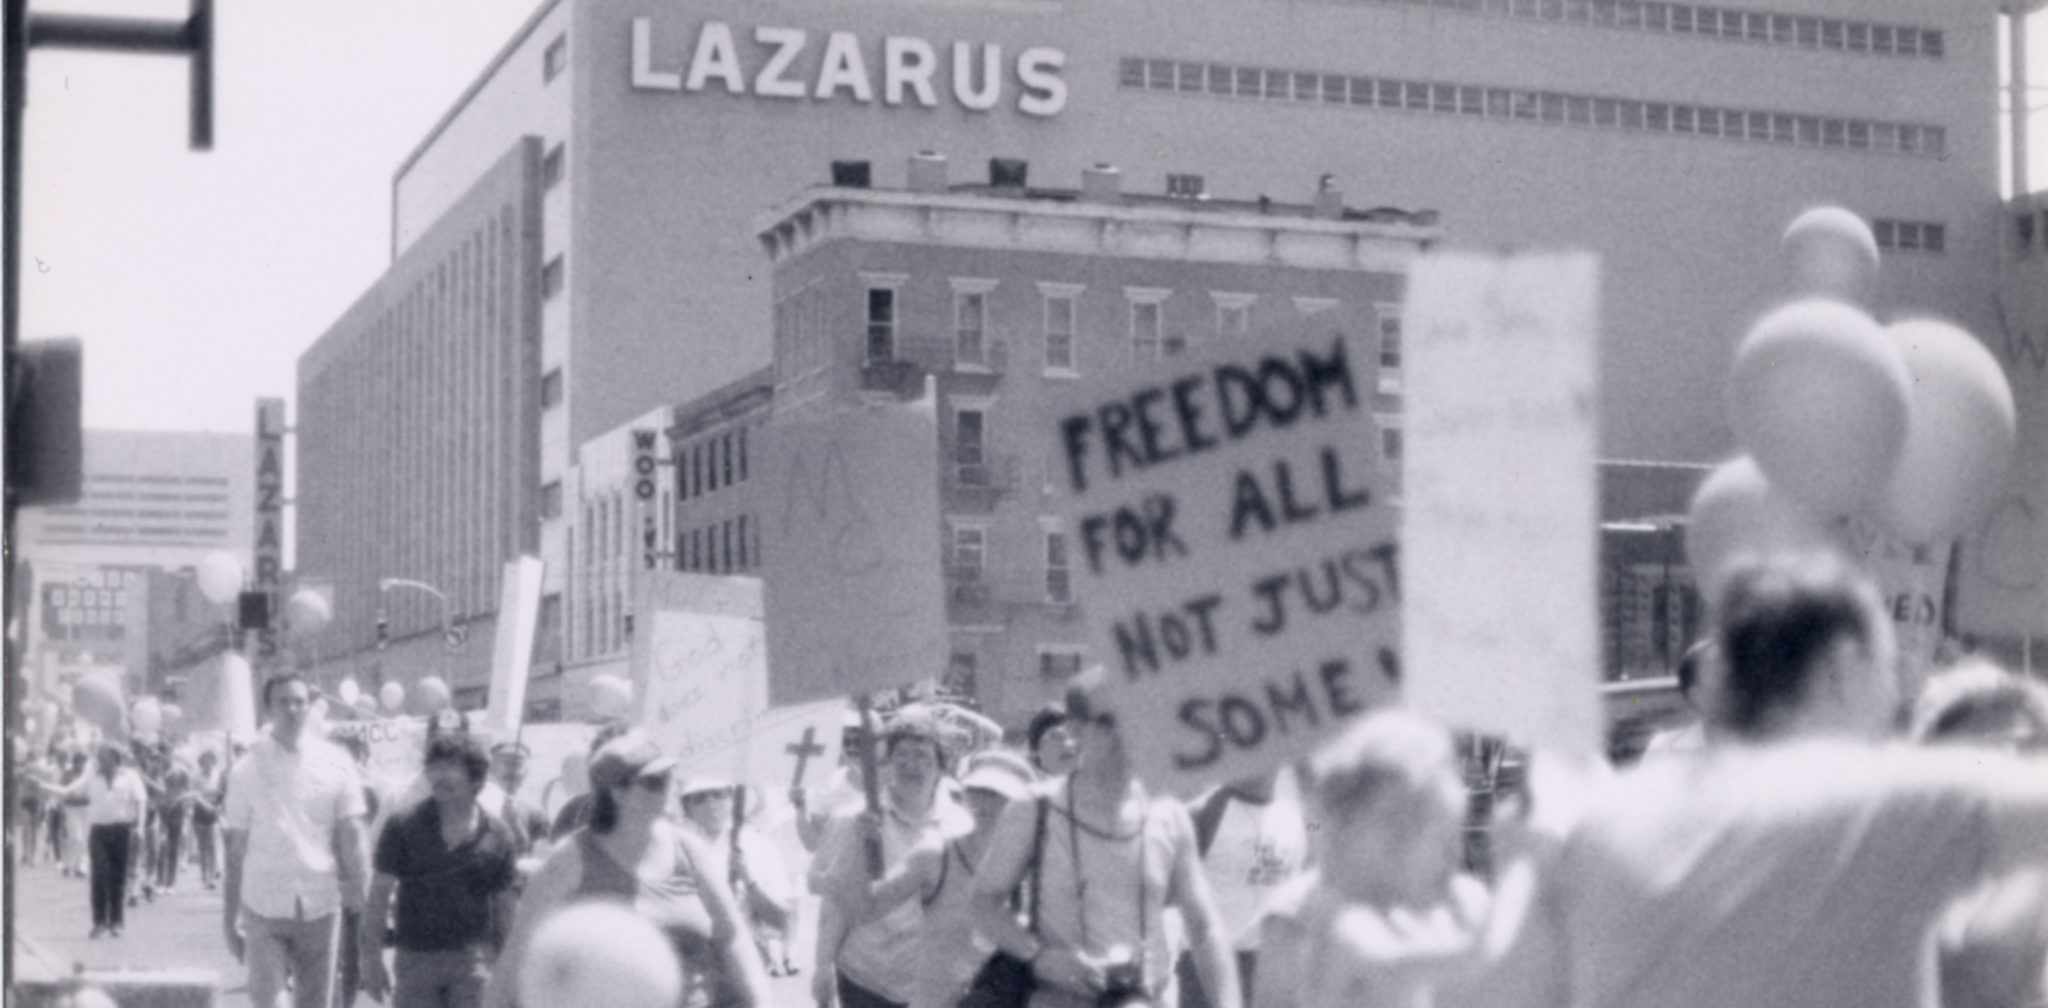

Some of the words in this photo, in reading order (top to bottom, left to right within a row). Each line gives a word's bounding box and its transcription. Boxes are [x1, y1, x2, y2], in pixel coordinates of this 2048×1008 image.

[632, 17, 1069, 117] LAZARUS
[1060, 334, 1357, 493] FREEDOM
[1080, 496, 1189, 575] FOR
[1228, 445, 1371, 541] ALL
[1112, 595, 1222, 683] NOT
[1250, 541, 1398, 637] JUST
